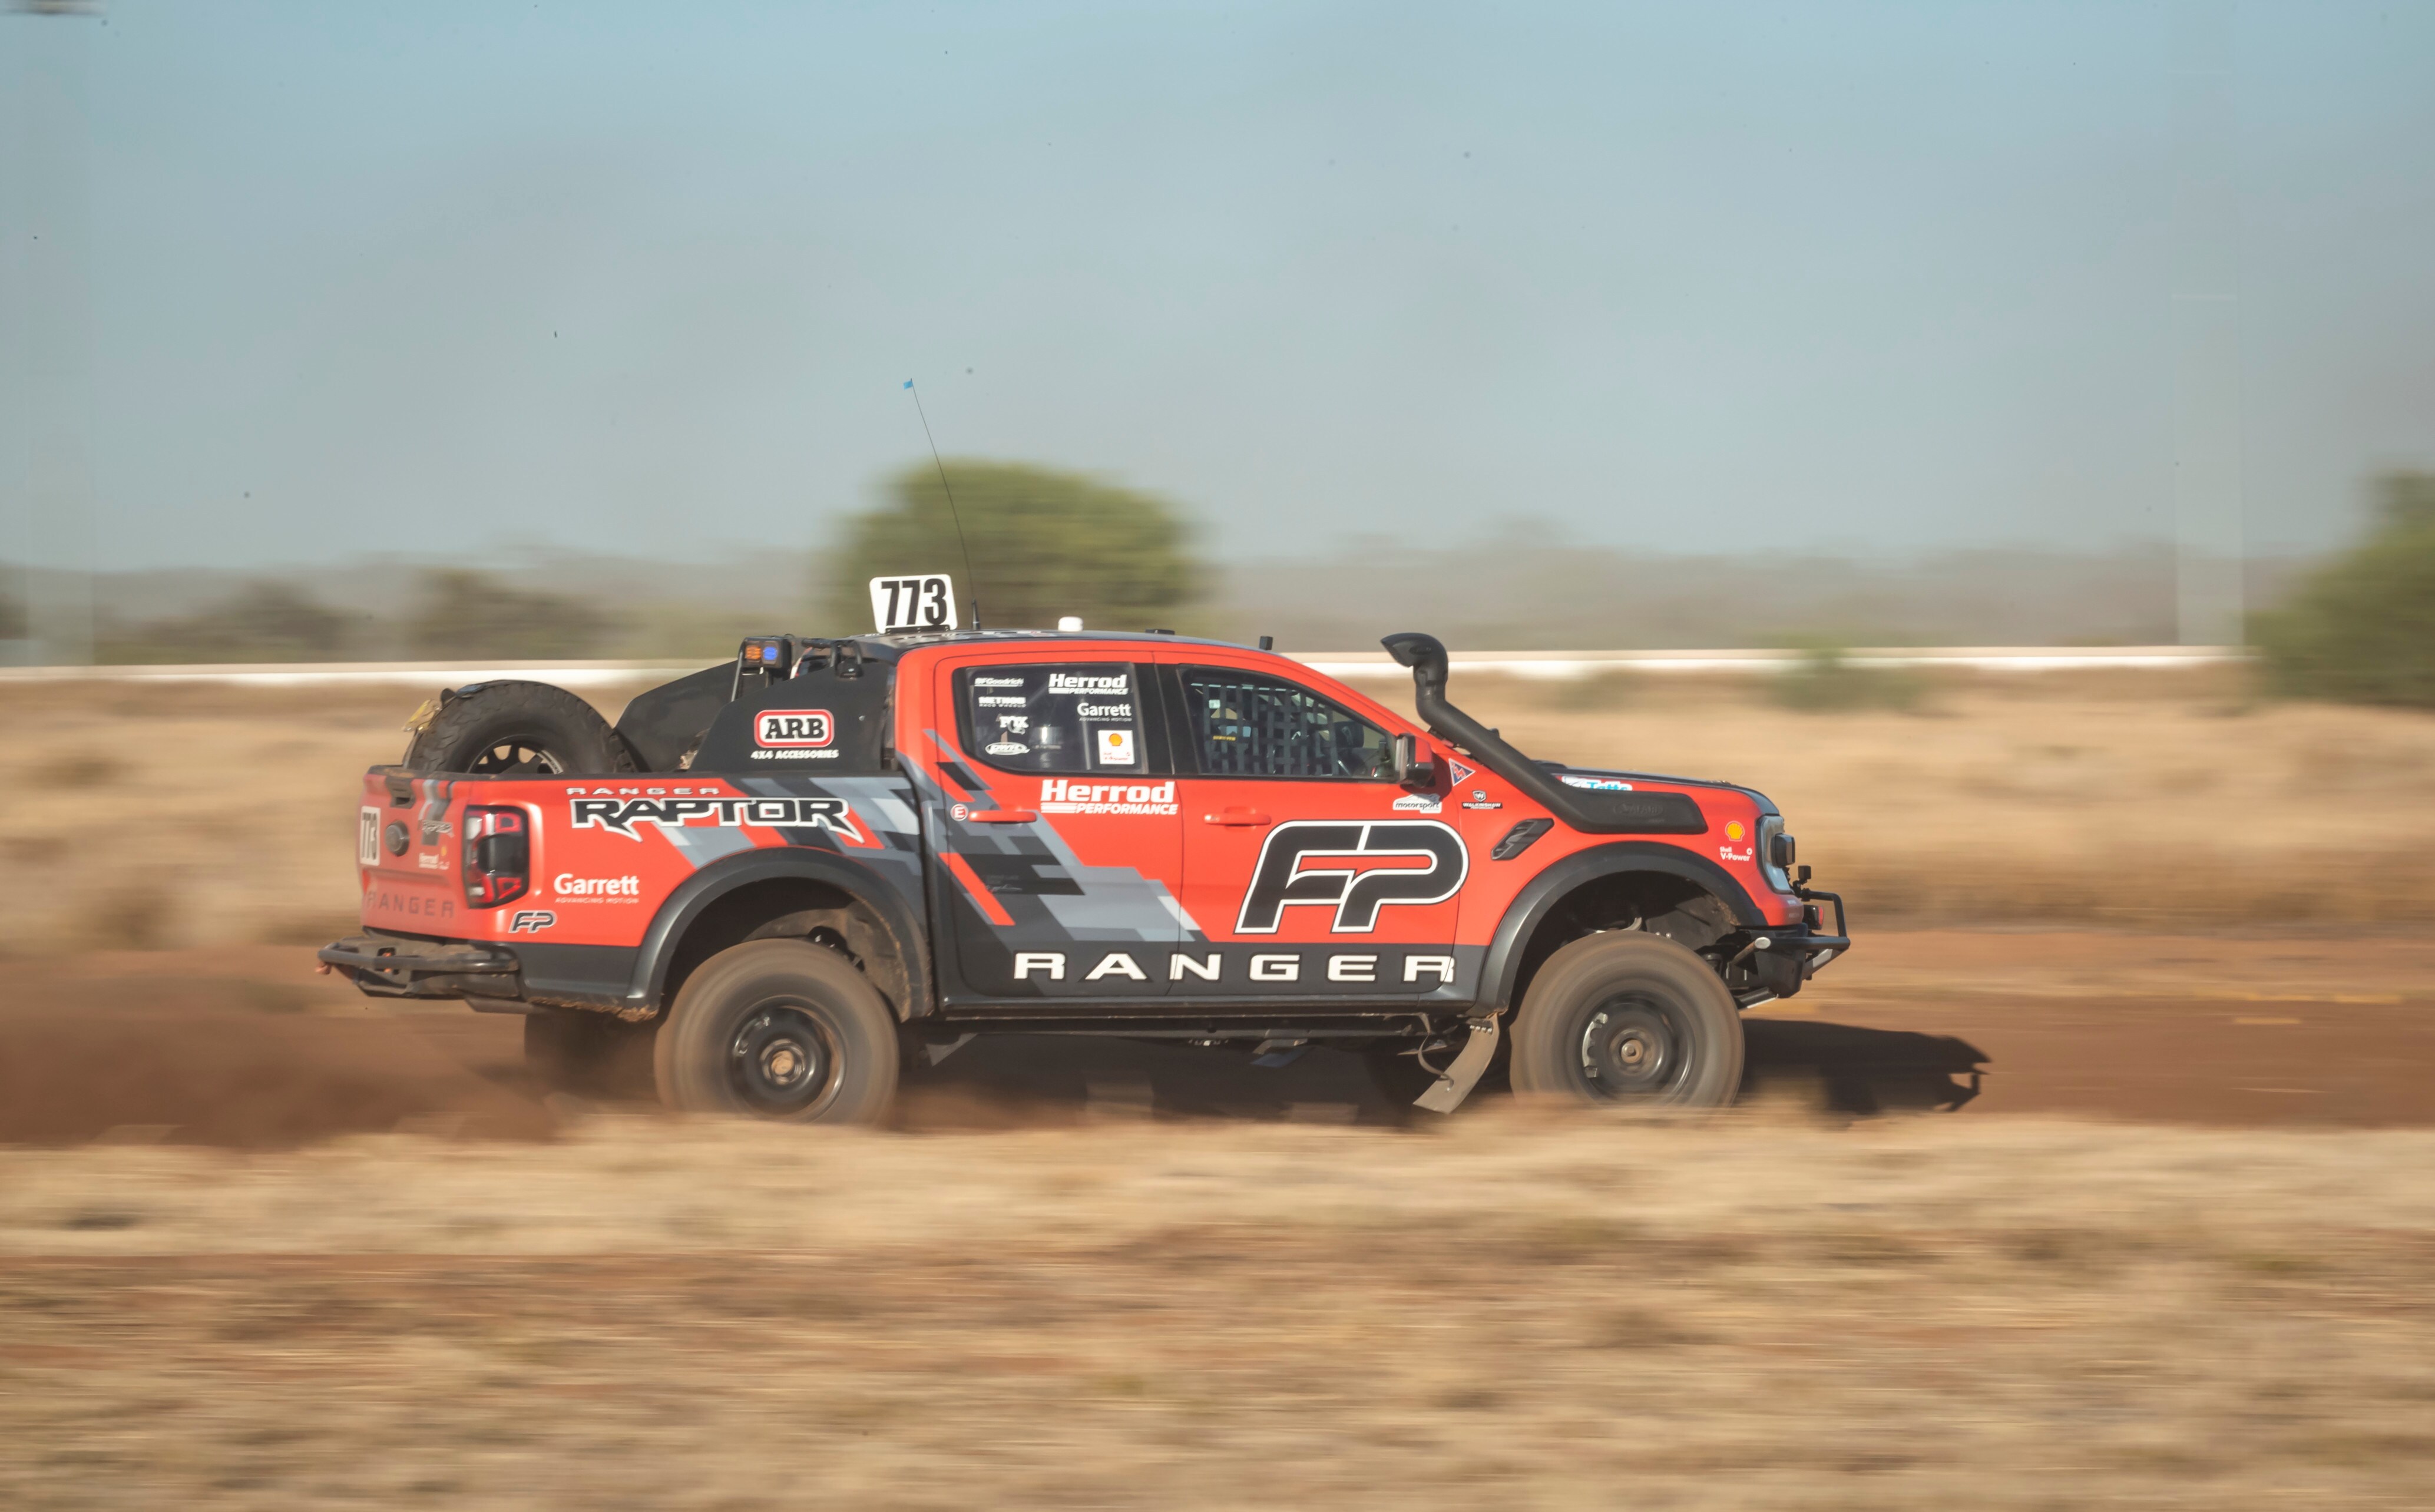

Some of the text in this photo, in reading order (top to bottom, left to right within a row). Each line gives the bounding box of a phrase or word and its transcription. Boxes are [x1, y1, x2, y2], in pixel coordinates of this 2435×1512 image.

[881, 578, 947, 626] 773
[1048, 673, 1127, 688] Herrod
[1077, 702, 1132, 716] Garrett
[765, 718, 824, 739] ARB
[775, 749, 839, 759] ACCESSORIES
[566, 787, 720, 795] RANGER
[1040, 779, 1176, 803] Herrod
[954, 807, 965, 819] E
[1076, 802, 1179, 815] PERFORMANCE
[570, 798, 865, 843] RAPTOR
[1720, 852, 1751, 862] V-Power
[554, 873, 640, 895] Garrett
[1233, 819, 1470, 935] FP
[367, 890, 454, 918] RANGER
[508, 910, 558, 934] FP
[1013, 953, 1455, 983] RANGER
